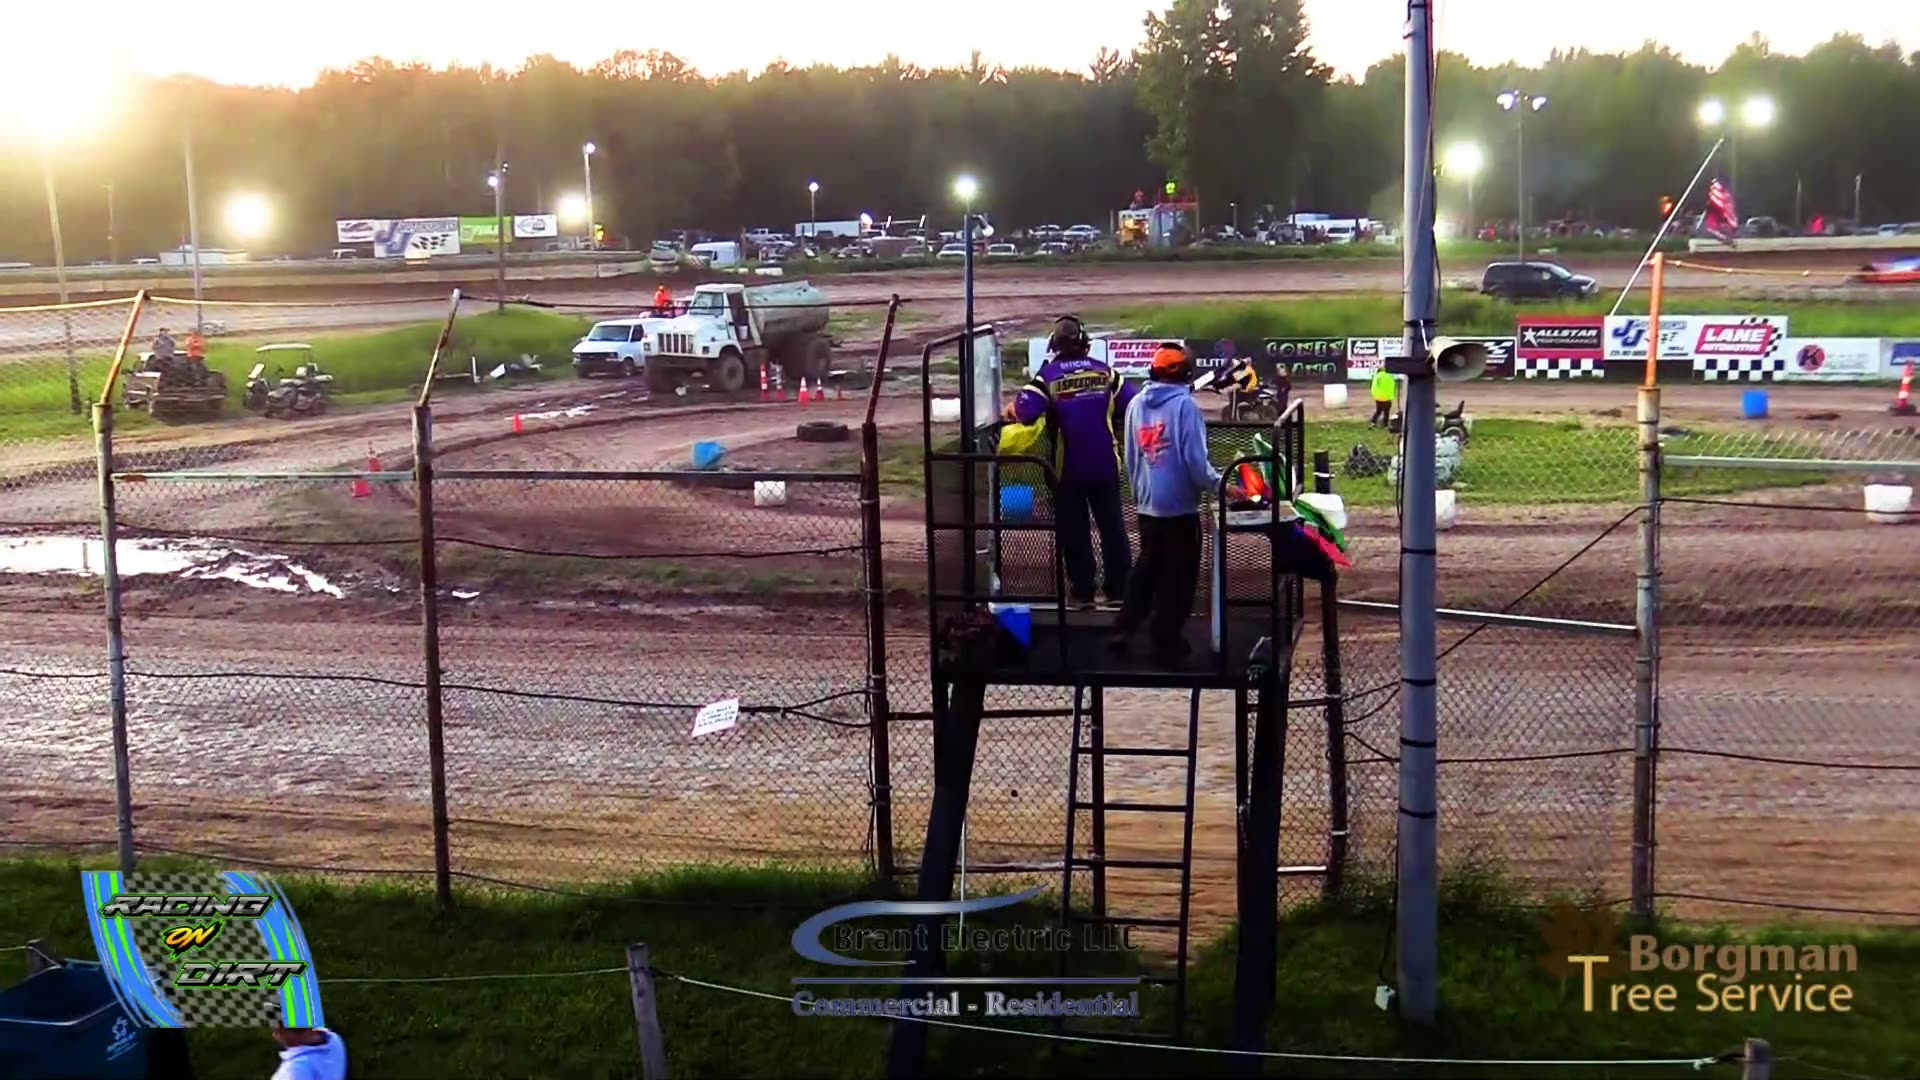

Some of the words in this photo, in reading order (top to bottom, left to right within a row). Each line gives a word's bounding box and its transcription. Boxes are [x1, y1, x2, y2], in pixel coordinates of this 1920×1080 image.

[1536, 329, 1598, 337] ALLSTAR
[1705, 328, 1767, 342] LANE
[1109, 342, 1161, 350] BATTER
